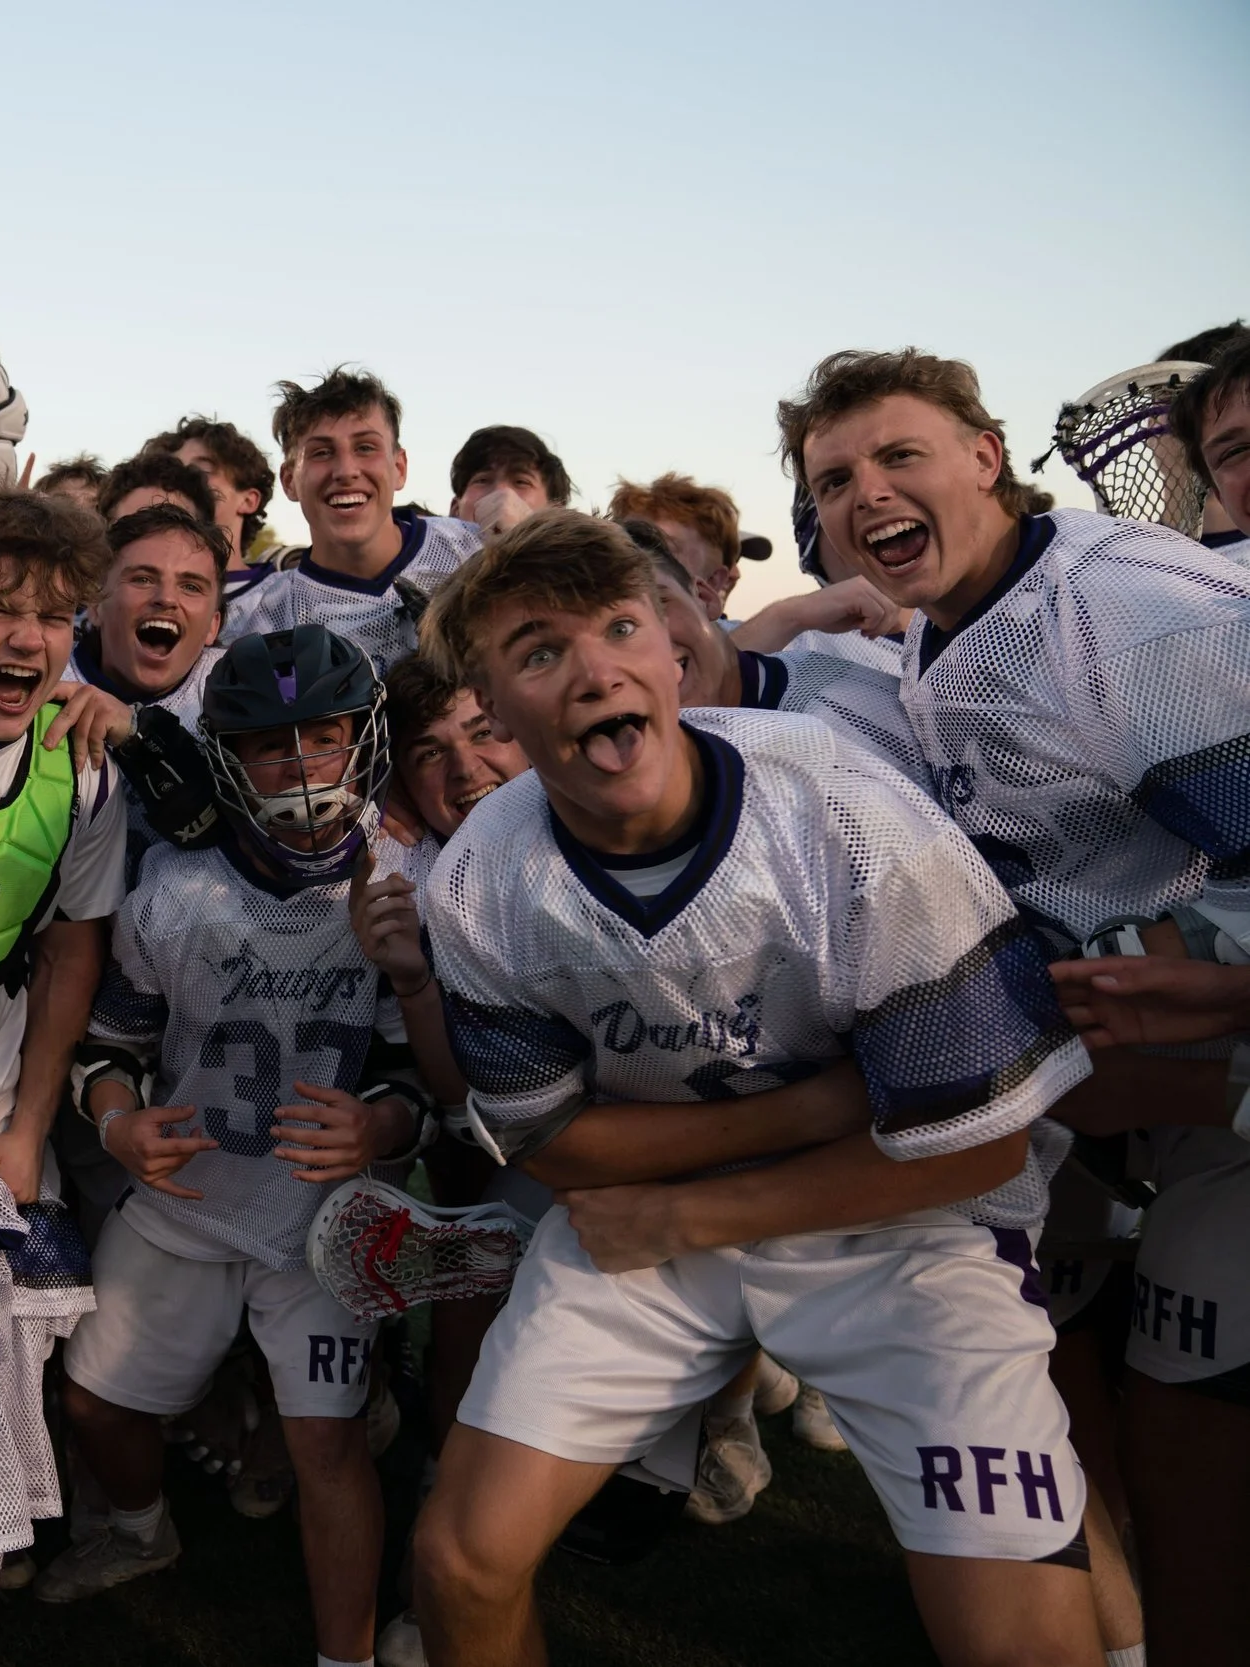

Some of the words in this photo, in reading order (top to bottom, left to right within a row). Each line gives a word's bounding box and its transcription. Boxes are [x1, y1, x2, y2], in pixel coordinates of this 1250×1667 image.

[173, 802, 218, 843] STX
[1132, 1271, 1218, 1360] RFH
[915, 1446, 1065, 1523] RFH
